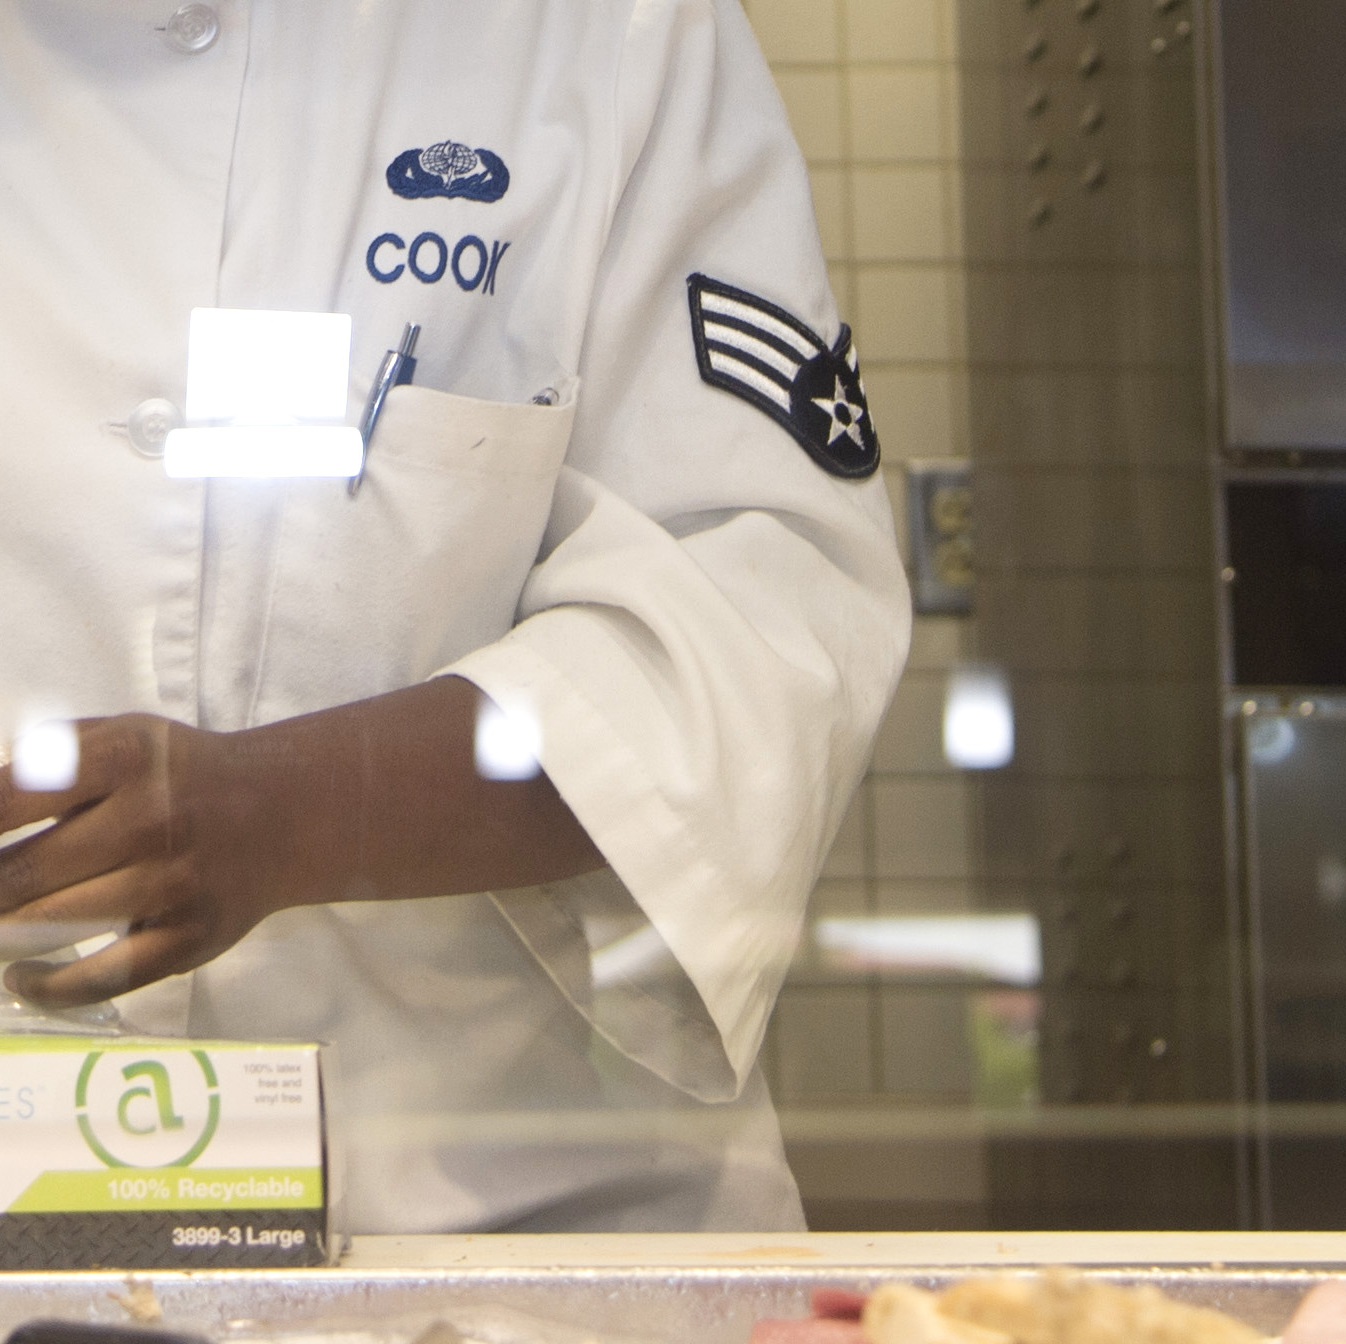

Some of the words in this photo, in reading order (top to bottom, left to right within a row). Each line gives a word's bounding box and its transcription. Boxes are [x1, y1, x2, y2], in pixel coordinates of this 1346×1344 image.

[108, 1179, 170, 1200] 100%
[177, 1176, 304, 1202] Recyclable
[172, 1226, 241, 1246] 3899-3
[246, 1225, 305, 1248] Large
